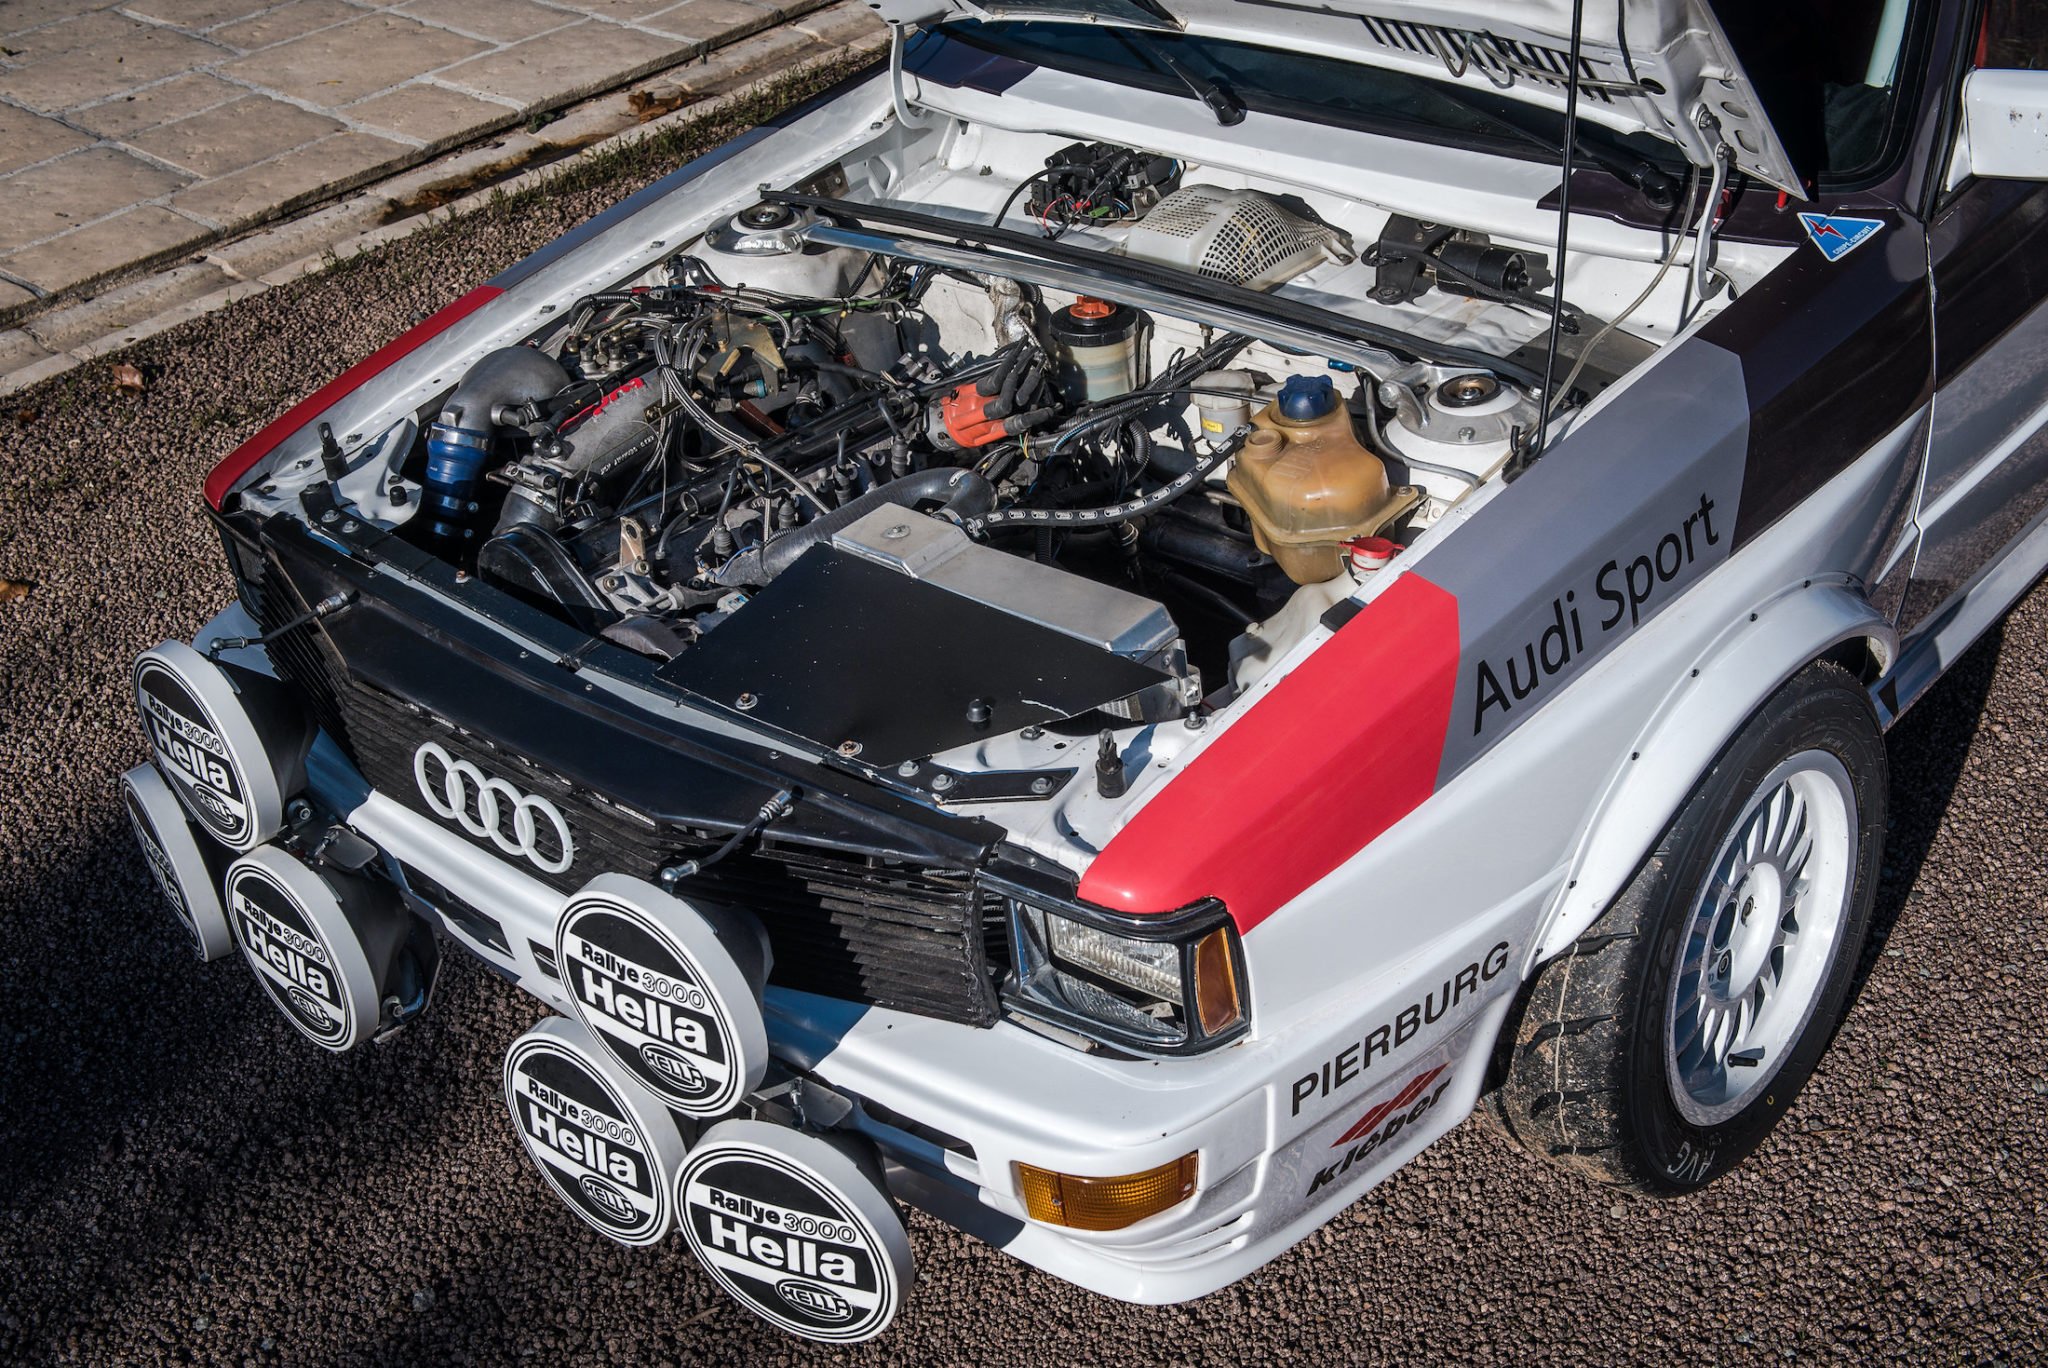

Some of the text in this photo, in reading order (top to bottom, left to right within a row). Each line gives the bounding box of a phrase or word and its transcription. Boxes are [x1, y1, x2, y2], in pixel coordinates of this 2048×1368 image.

[1473, 492, 1719, 737] Audi Sport
[147, 694, 224, 756] Rallye 3000
[151, 716, 232, 795] Hella
[243, 897, 326, 963] Rallye 3000
[245, 919, 331, 1000] Hella
[581, 940, 706, 1010] Rallye 3000
[581, 966, 708, 1055] Hella
[1291, 941, 1510, 1118] PIERBURG
[644, 1049, 705, 1090] HELLA
[528, 1077, 636, 1147] Rallye 3000
[528, 1101, 639, 1189] Hella
[583, 1181, 636, 1221] HELLA
[709, 1188, 857, 1244] Rallye 3000
[709, 1213, 857, 1285] Hella
[780, 1286, 850, 1318] HELLA
